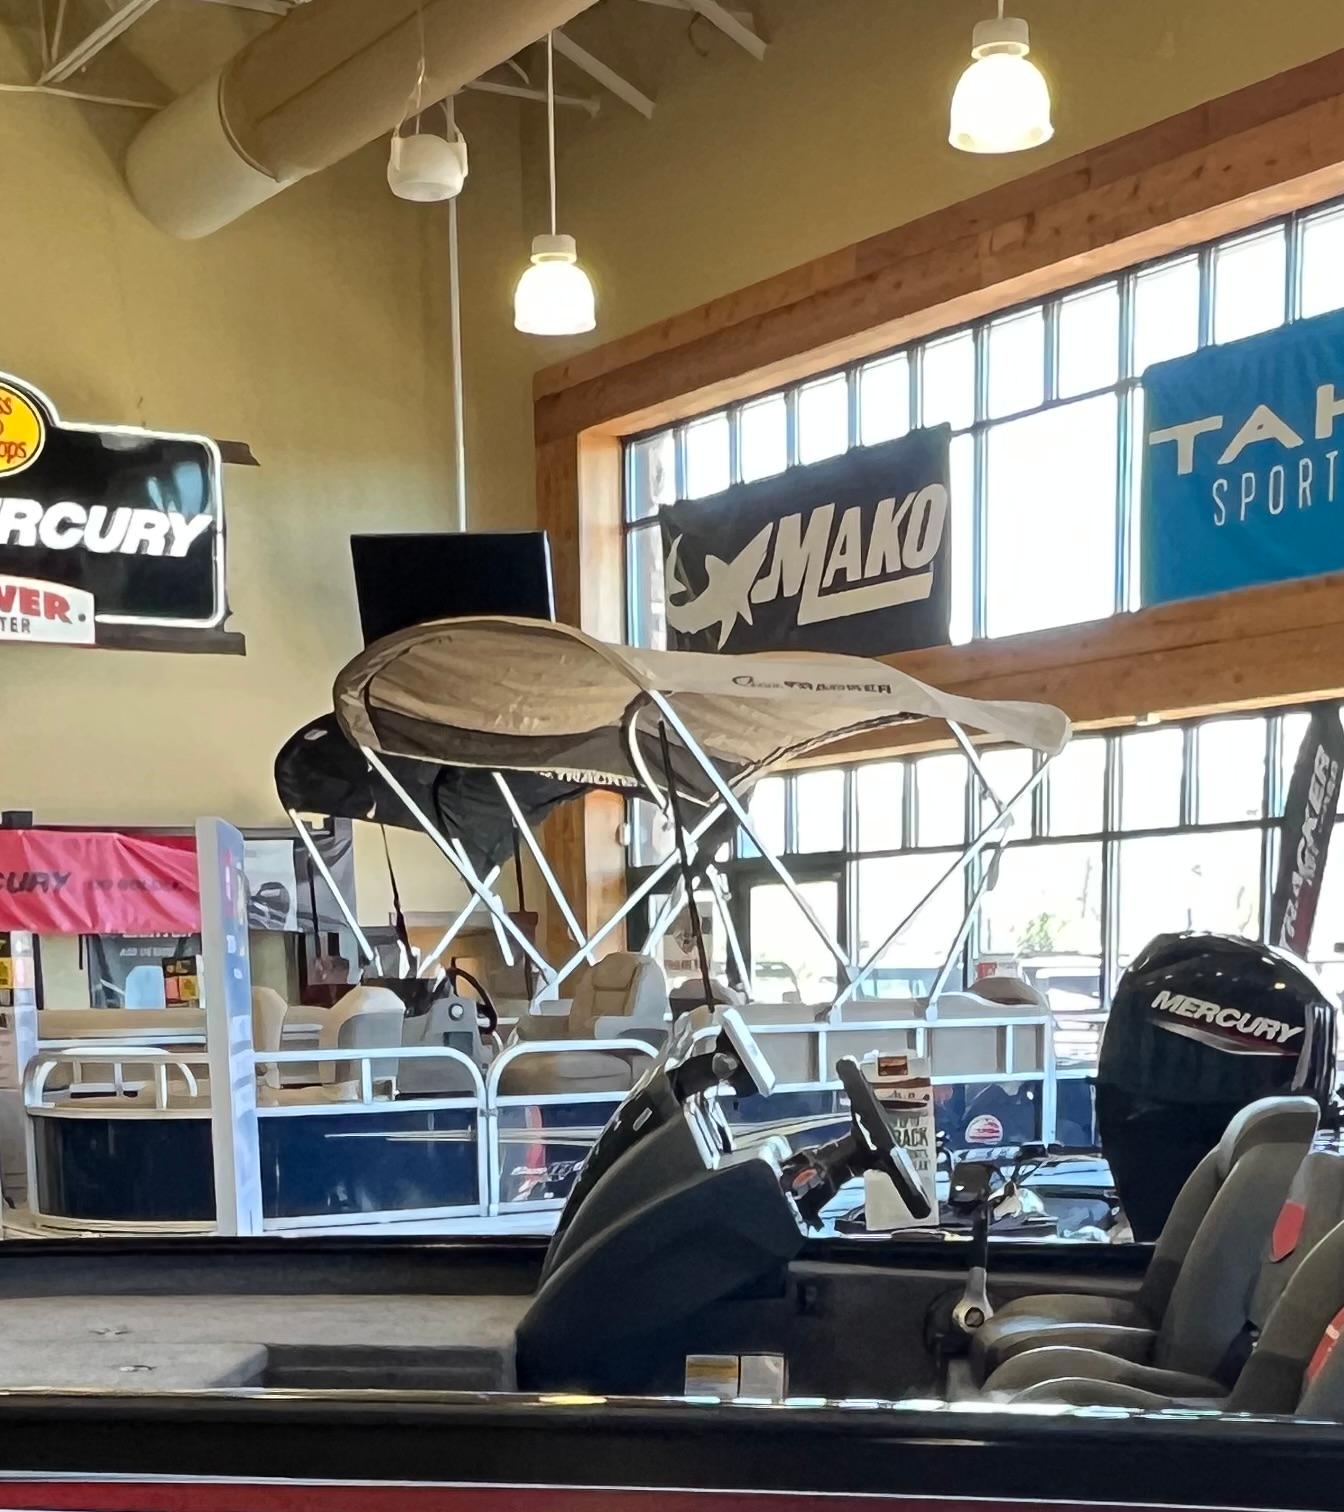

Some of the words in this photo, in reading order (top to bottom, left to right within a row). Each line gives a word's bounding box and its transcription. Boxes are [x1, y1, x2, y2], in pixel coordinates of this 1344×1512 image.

[1211, 450, 1338, 527] SPORT
[750, 483, 948, 626] MAKO
[1151, 990, 1305, 1044] MERCURY
